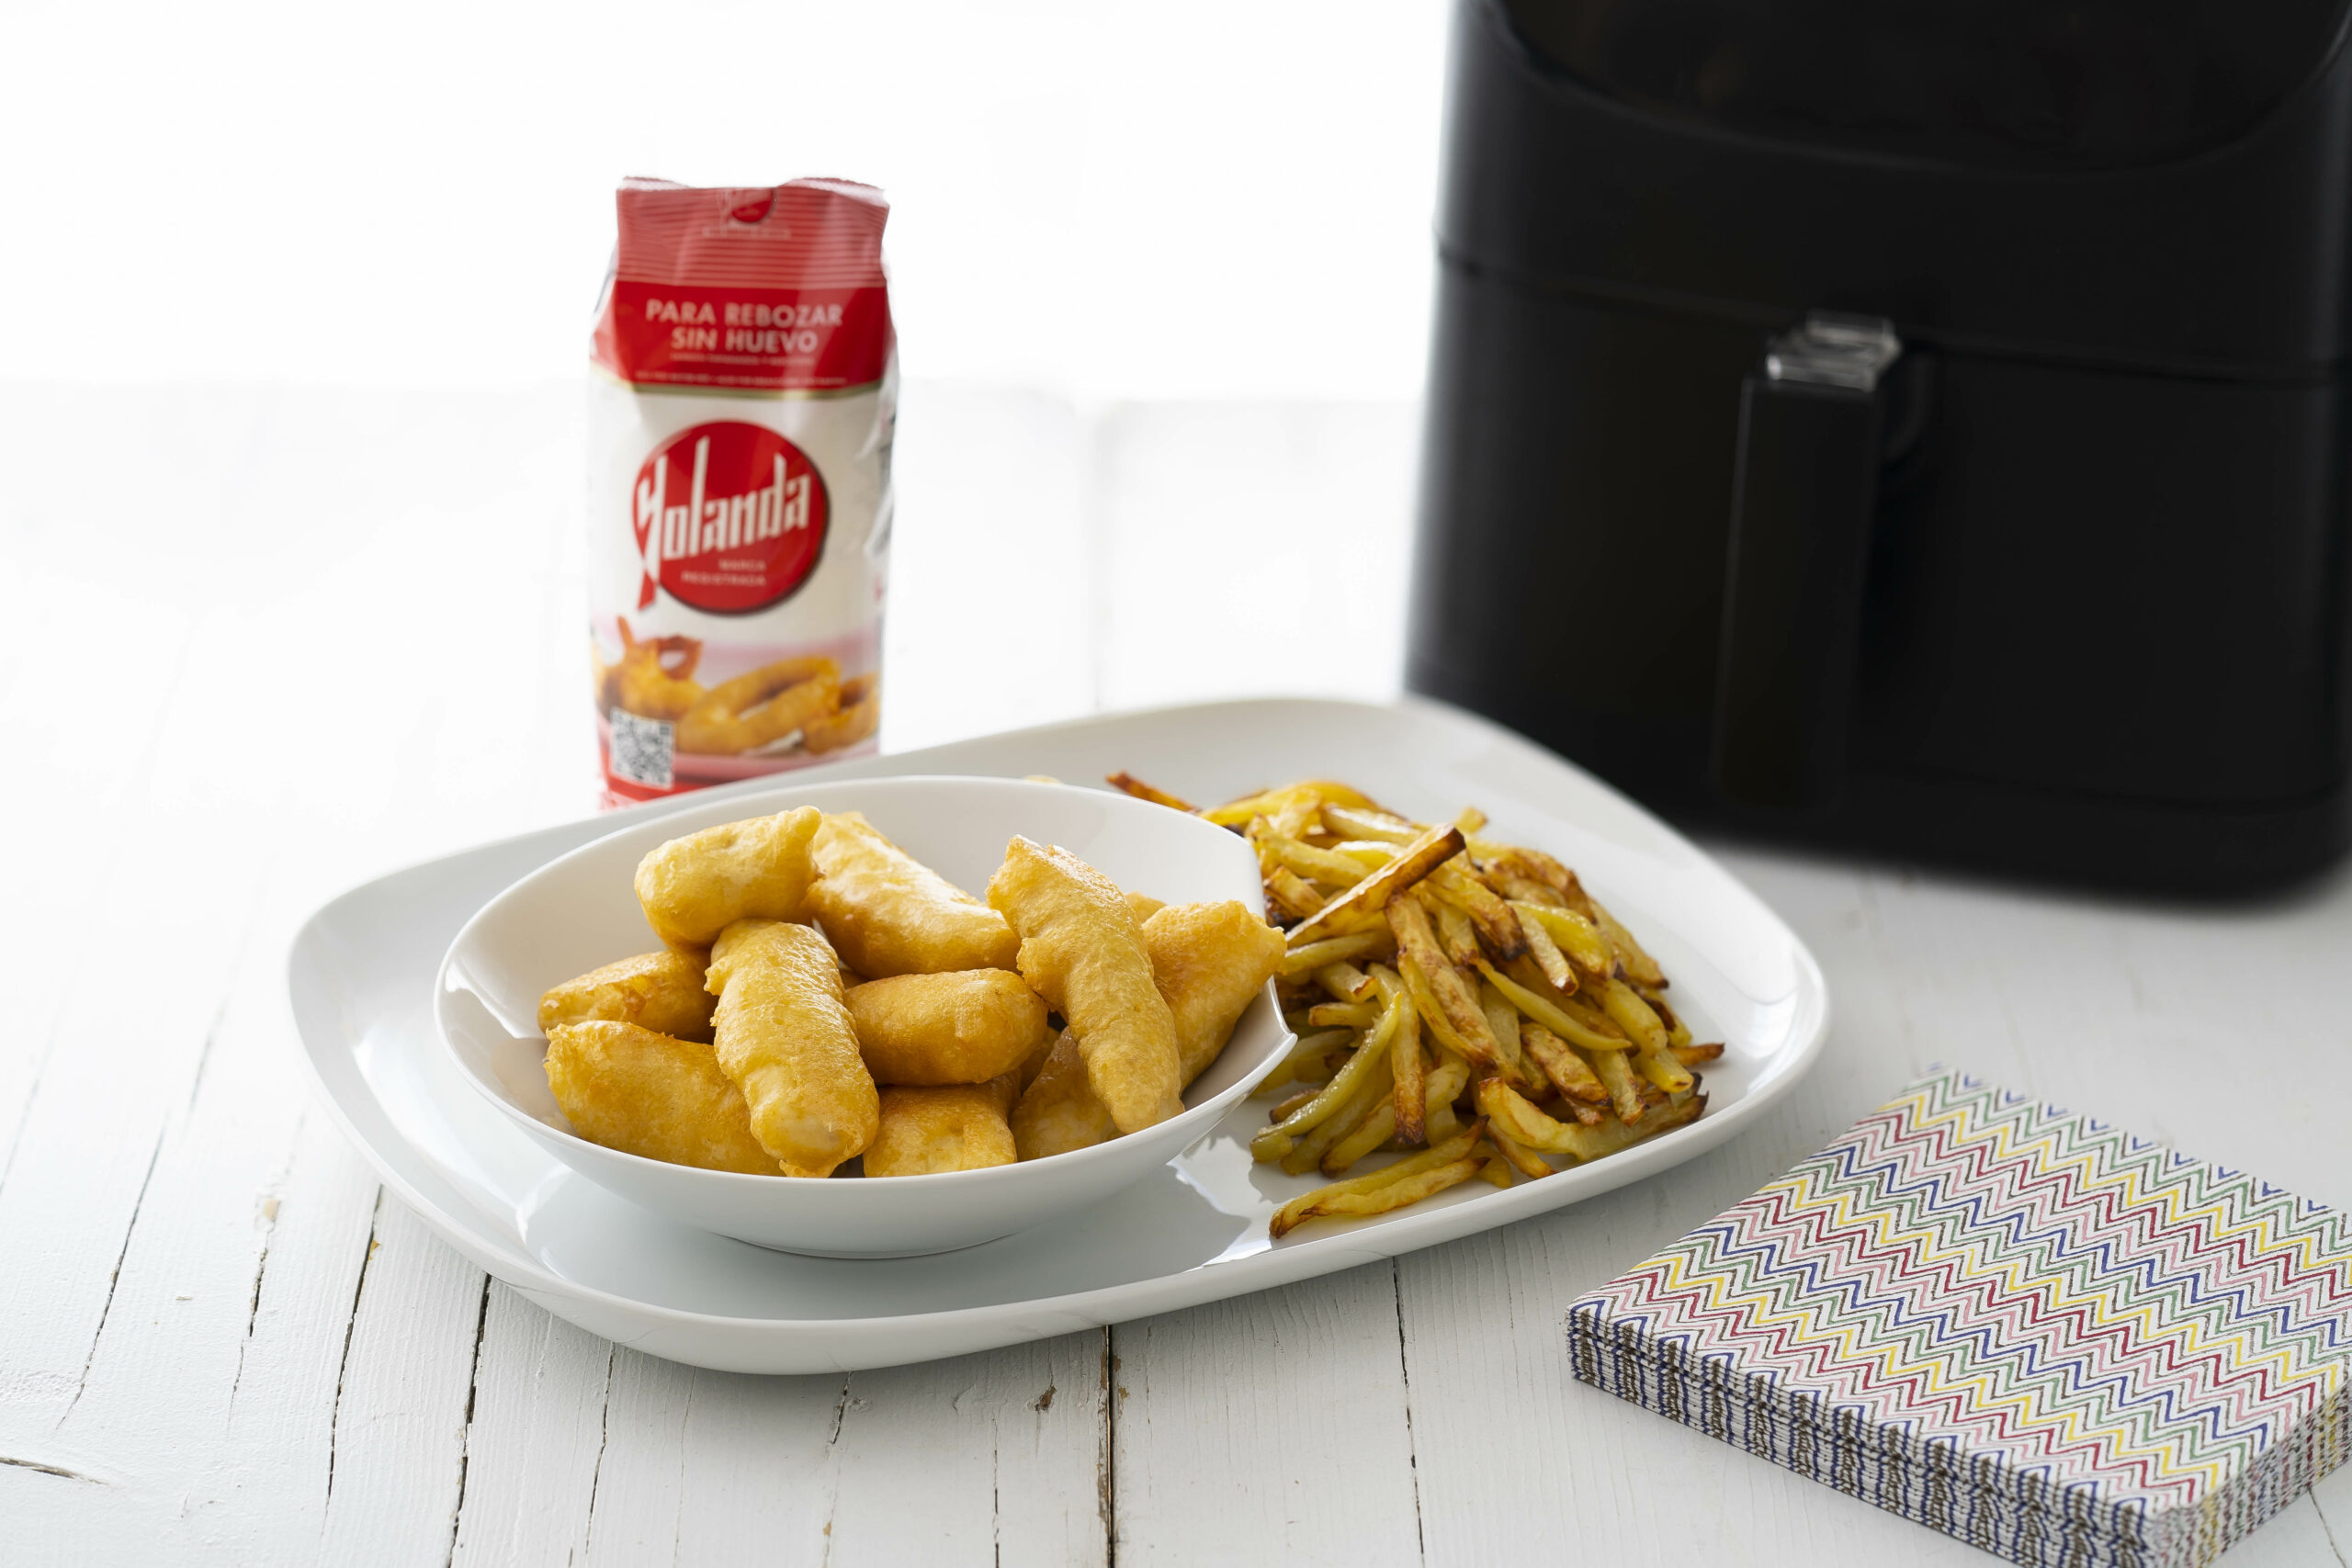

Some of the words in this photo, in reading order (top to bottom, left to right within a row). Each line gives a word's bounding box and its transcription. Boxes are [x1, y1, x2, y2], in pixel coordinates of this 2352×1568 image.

[646, 299, 716, 325] PARA
[724, 303, 843, 328] REBOZAR
[671, 327, 717, 351] SIN
[725, 330, 819, 354] HUEVO
[637, 435, 812, 606] Yolanda
[681, 570, 766, 586] REGISTRADA
[718, 558, 766, 571] MARCA
